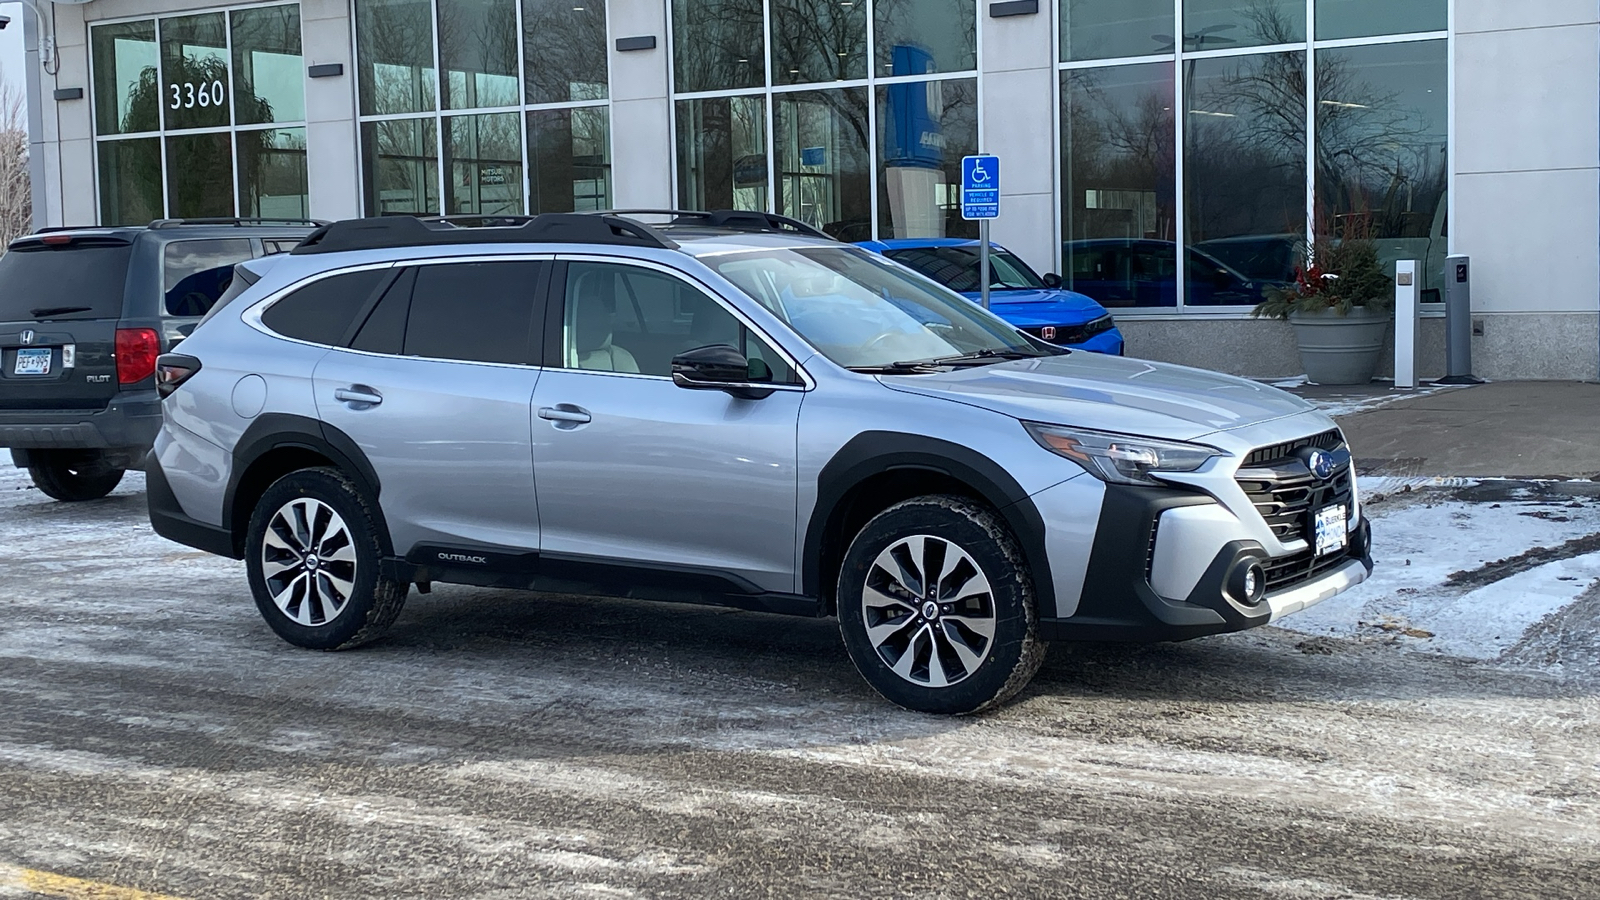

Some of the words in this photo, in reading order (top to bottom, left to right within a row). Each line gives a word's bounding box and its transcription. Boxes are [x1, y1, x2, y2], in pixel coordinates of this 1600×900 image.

[170, 80, 224, 109] 3360
[86, 375, 111, 383] PILOT
[438, 552, 487, 564] OUTBACK
